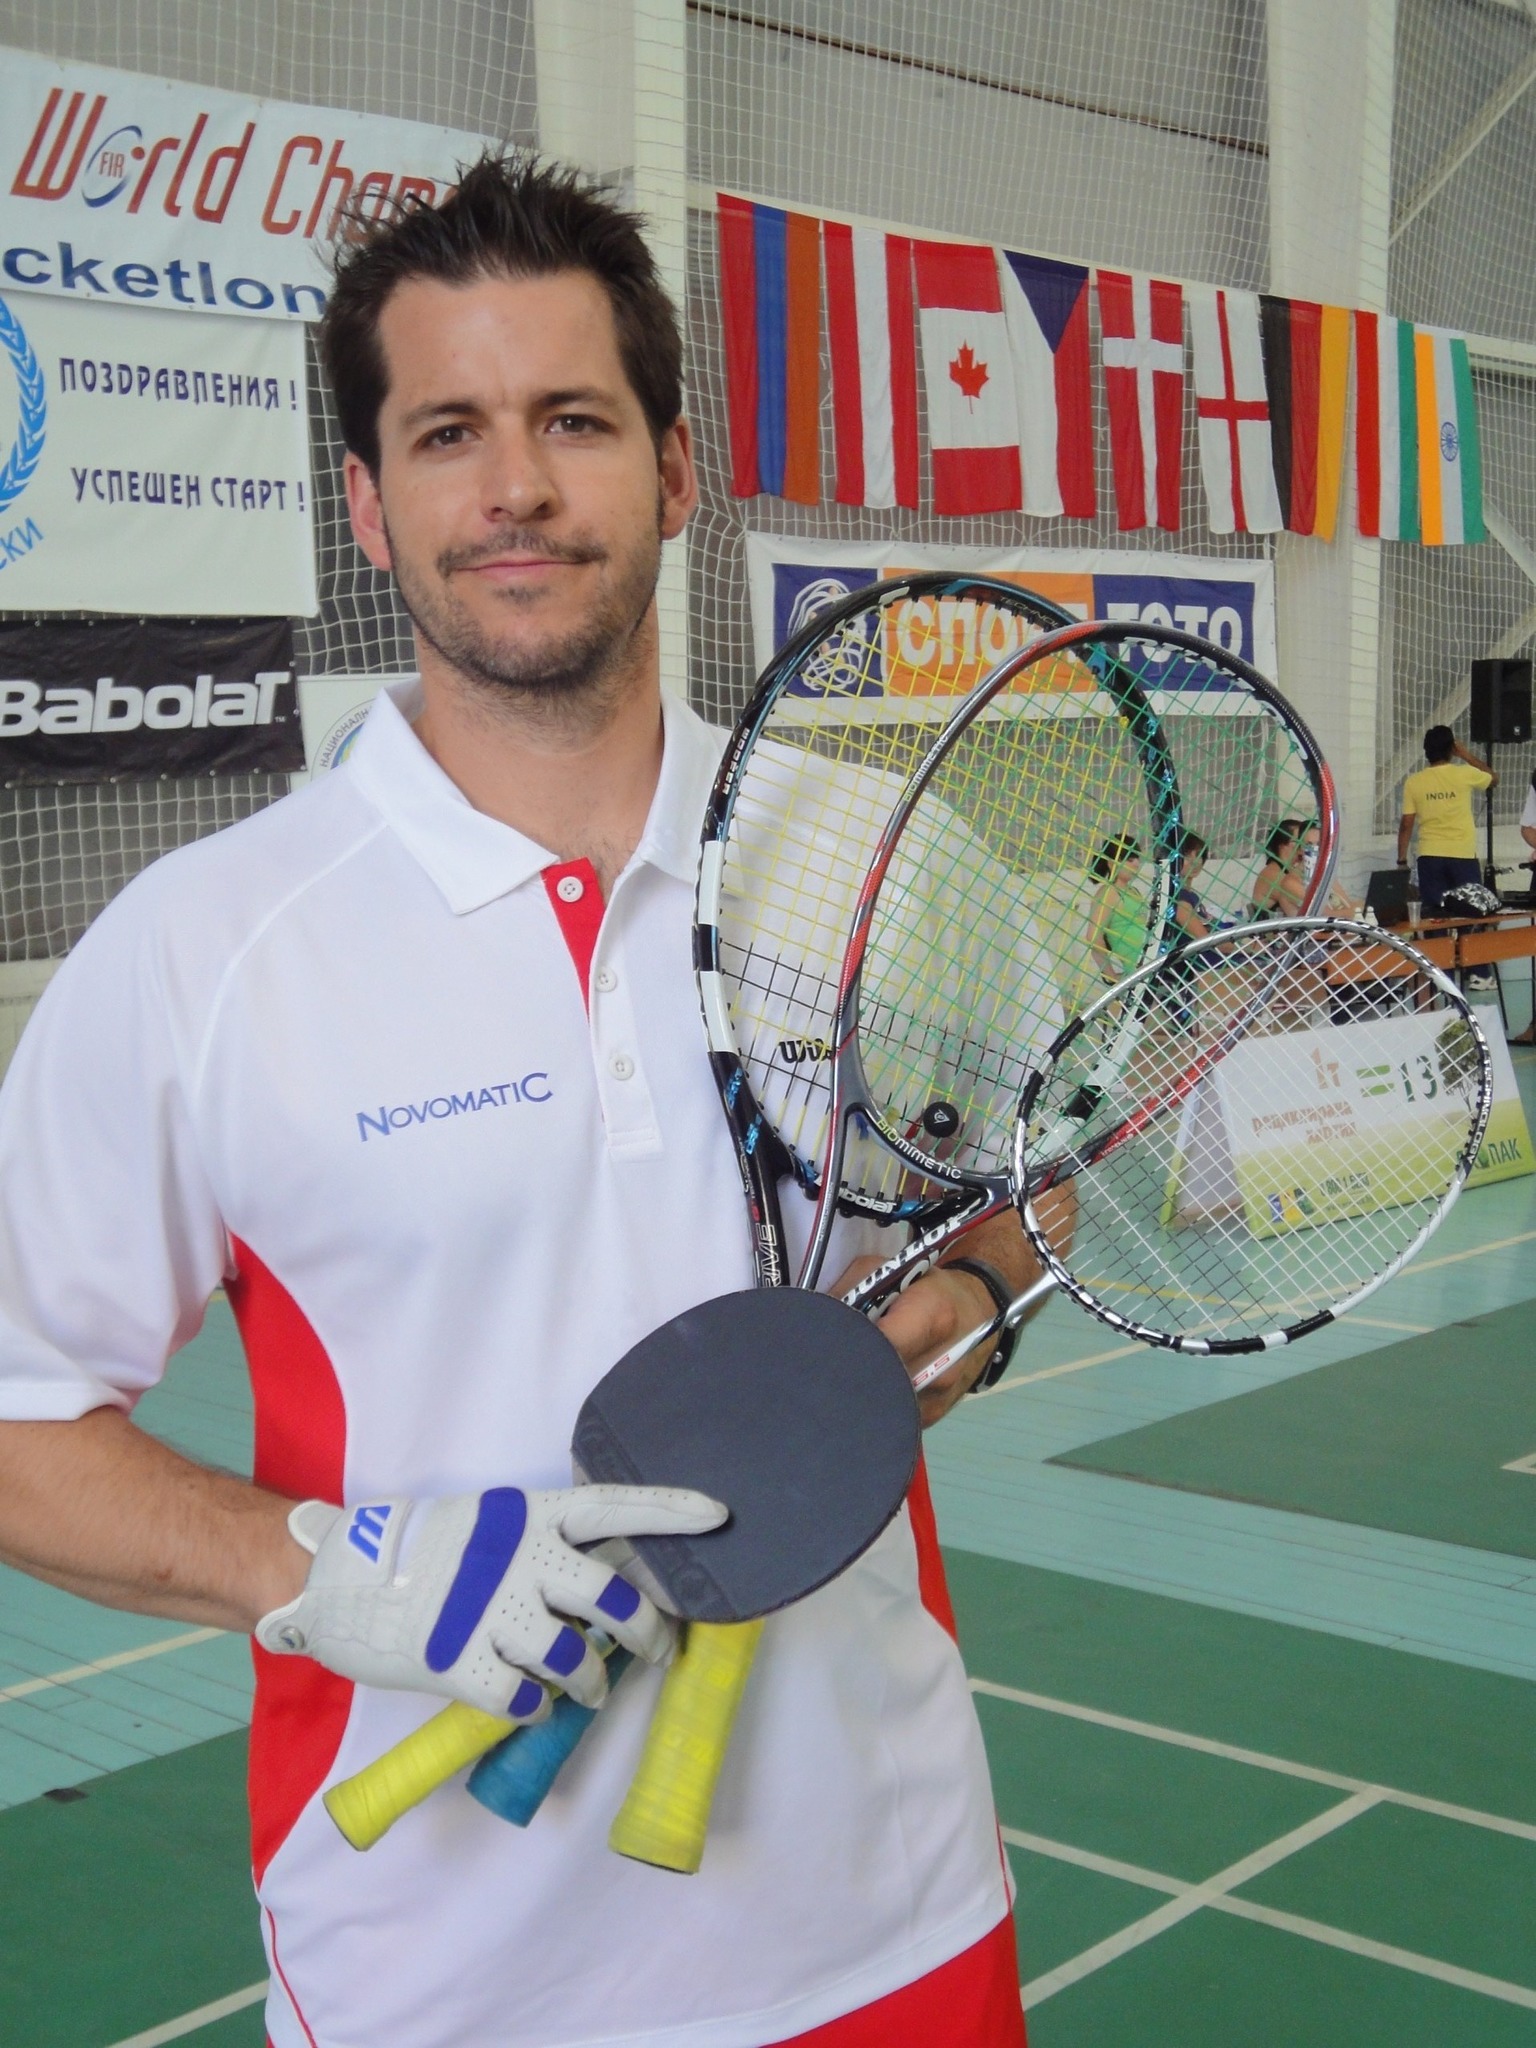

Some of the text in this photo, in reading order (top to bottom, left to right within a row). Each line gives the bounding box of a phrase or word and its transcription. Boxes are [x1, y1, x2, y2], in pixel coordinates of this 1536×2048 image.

[10, 87, 458, 242] World Cham
[99, 152, 125, 178] FIR
[2, 241, 327, 315] cketlon
[71, 467, 202, 508] УСПЕШЕН
[0, 516, 44, 570] КИ
[320, 705, 374, 768] НАЦИОНАЛН
[1425, 791, 1456, 801] INDIA
[355, 1072, 554, 1143] NOVOMATIC
[876, 1118, 963, 1180] BIOMIMETIC
